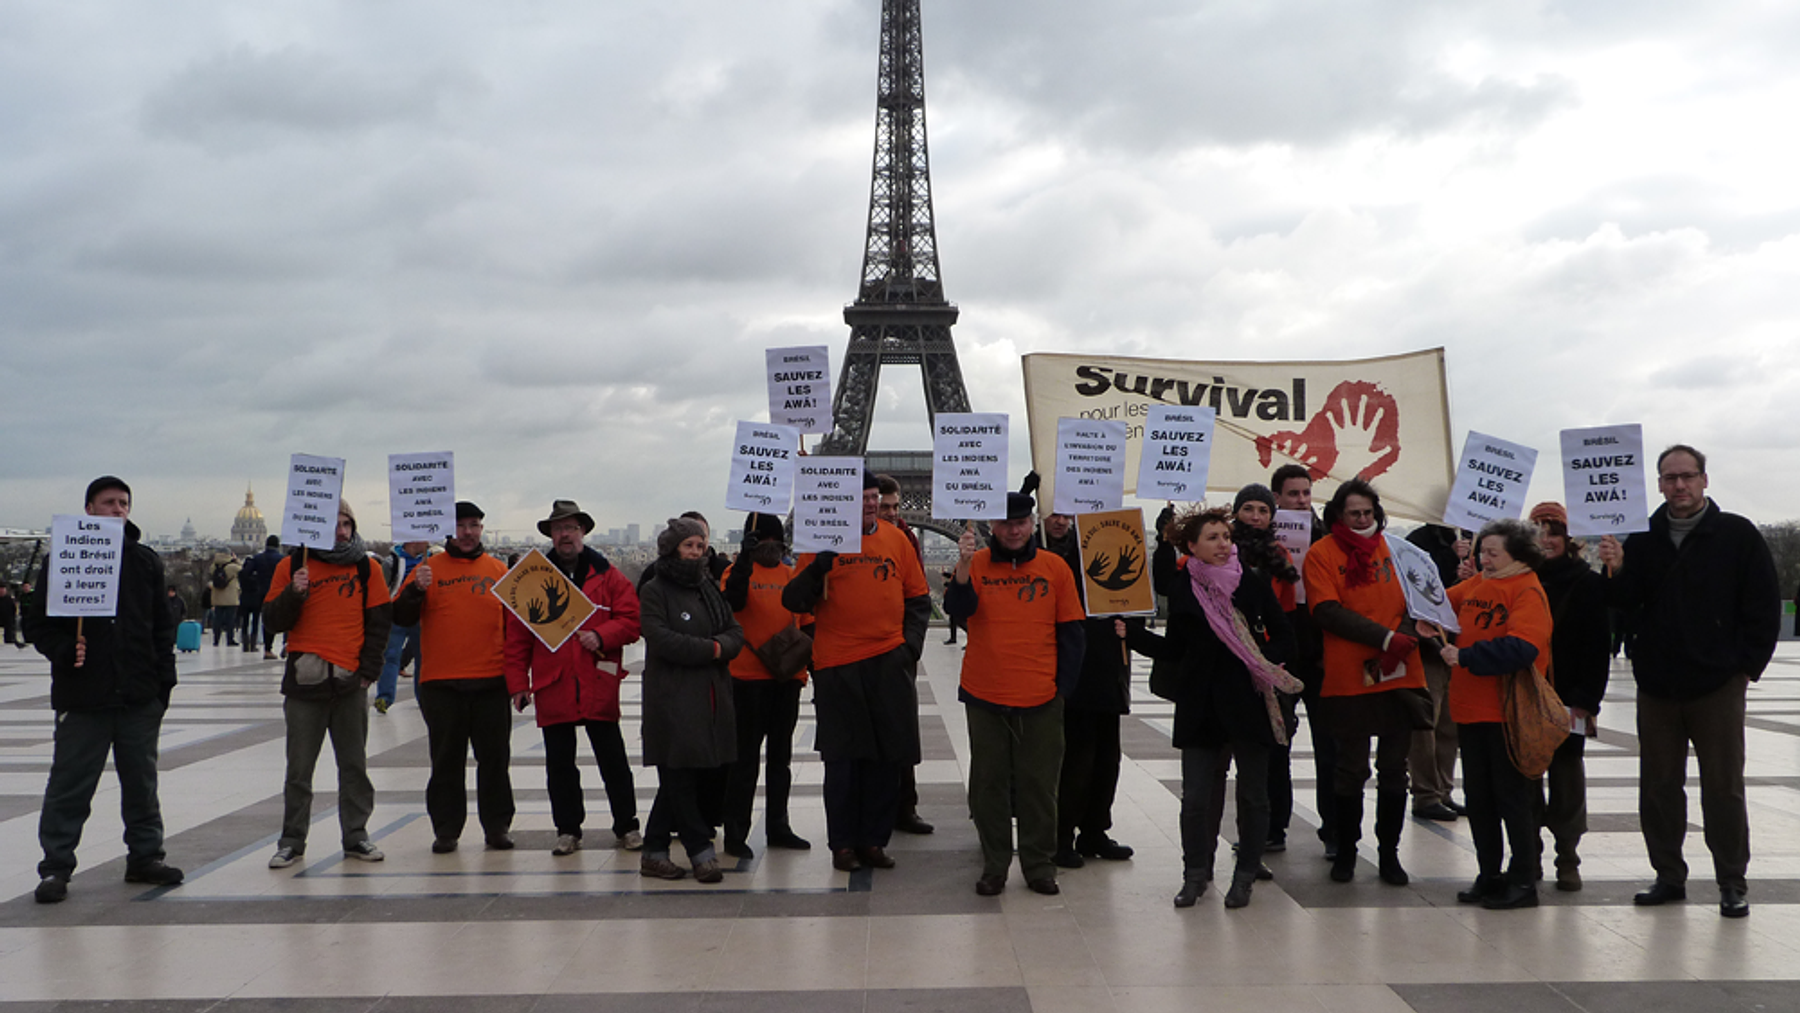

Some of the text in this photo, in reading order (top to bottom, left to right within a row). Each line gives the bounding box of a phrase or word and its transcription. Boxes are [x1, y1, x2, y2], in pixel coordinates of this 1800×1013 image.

[774, 371, 823, 383] SAUVEZ
[788, 385, 811, 395] LES
[1074, 365, 1306, 421] Survival
[1124, 401, 1149, 417] les
[940, 424, 1002, 435] SOLIDARITÉ
[1150, 430, 1205, 443] SAUVEZ
[740, 444, 789, 460] SAUVEZ
[1162, 445, 1189, 457] LES
[1068, 454, 1112, 463] TERRITOIRE
[1571, 454, 1635, 471] SAUVEZ
[750, 461, 774, 472] LES
[1468, 459, 1524, 484] SAUVEZ
[817, 481, 840, 489] AVEC
[1477, 477, 1504, 493] LES
[1589, 472, 1620, 486] LES
[945, 483, 959, 491] DU
[78, 520, 101, 531] Les
[65, 535, 111, 546] Indiens
[59, 549, 116, 560] du Brésil
[838, 555, 883, 566] Survival
[60, 564, 114, 575] ont droit
[64, 579, 107, 590] à leurs
[438, 575, 481, 587] Survival
[981, 574, 1031, 586] Survival
[1463, 596, 1494, 610] rvival
